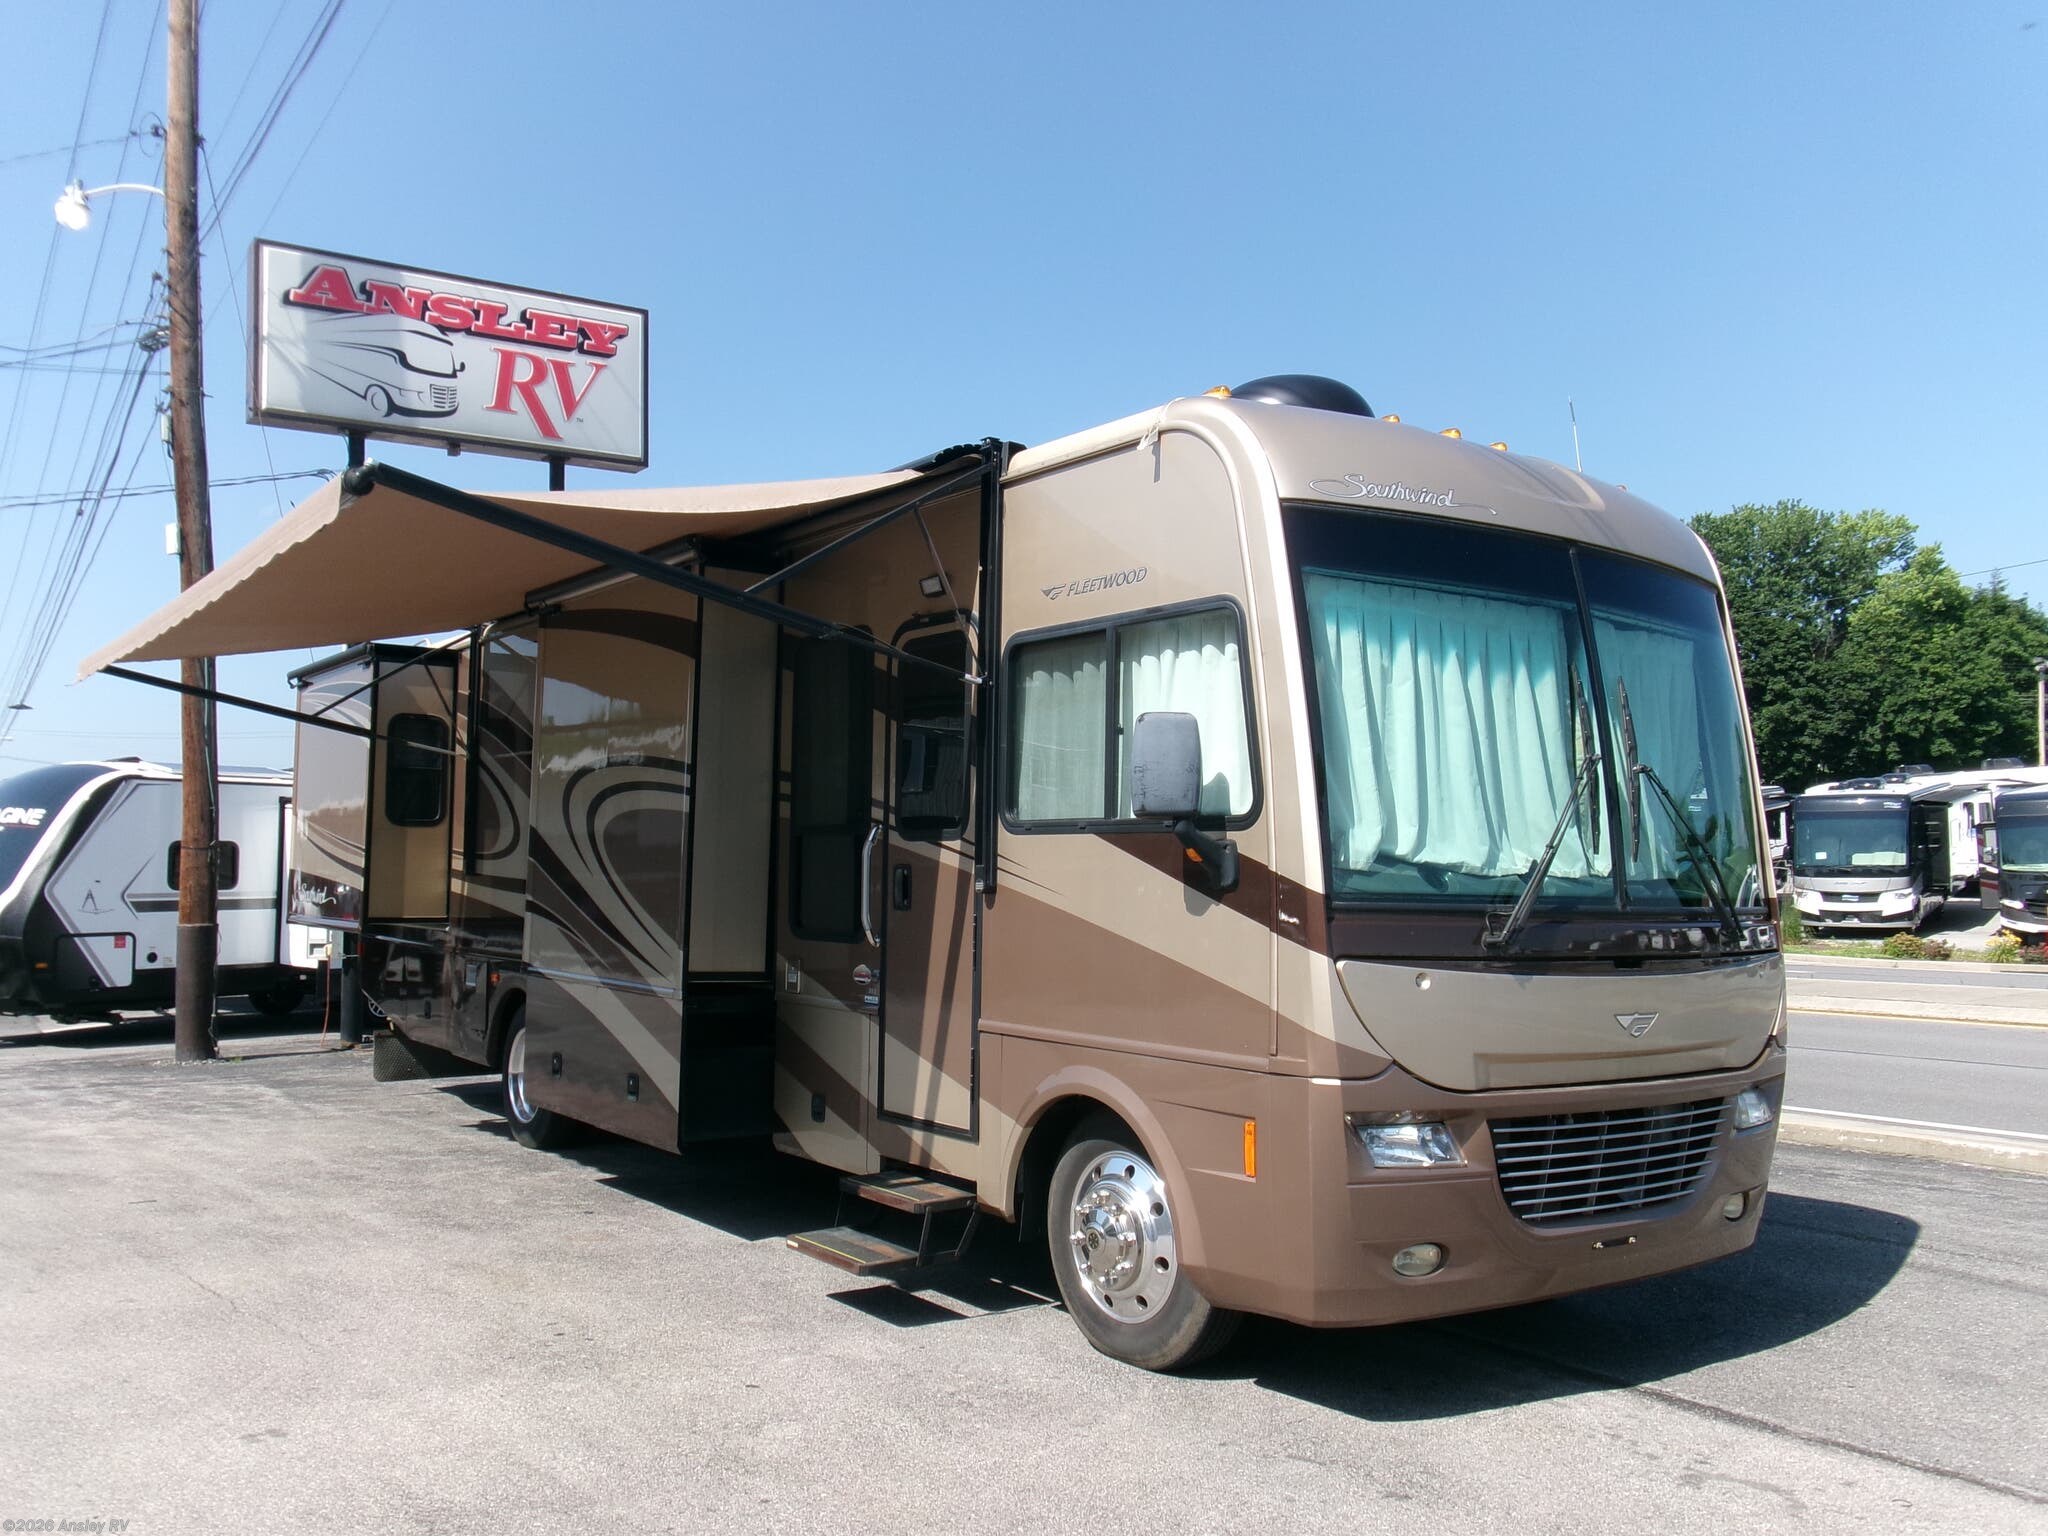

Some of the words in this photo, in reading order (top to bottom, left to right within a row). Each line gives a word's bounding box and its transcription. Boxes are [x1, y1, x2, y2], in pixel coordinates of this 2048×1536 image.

[284, 264, 629, 357] ANSLEY
[484, 346, 608, 440] RV
[1308, 473, 1497, 515] Southwind
[1066, 566, 1148, 597] FLEETWOOD
[0, 806, 47, 826] GINE
